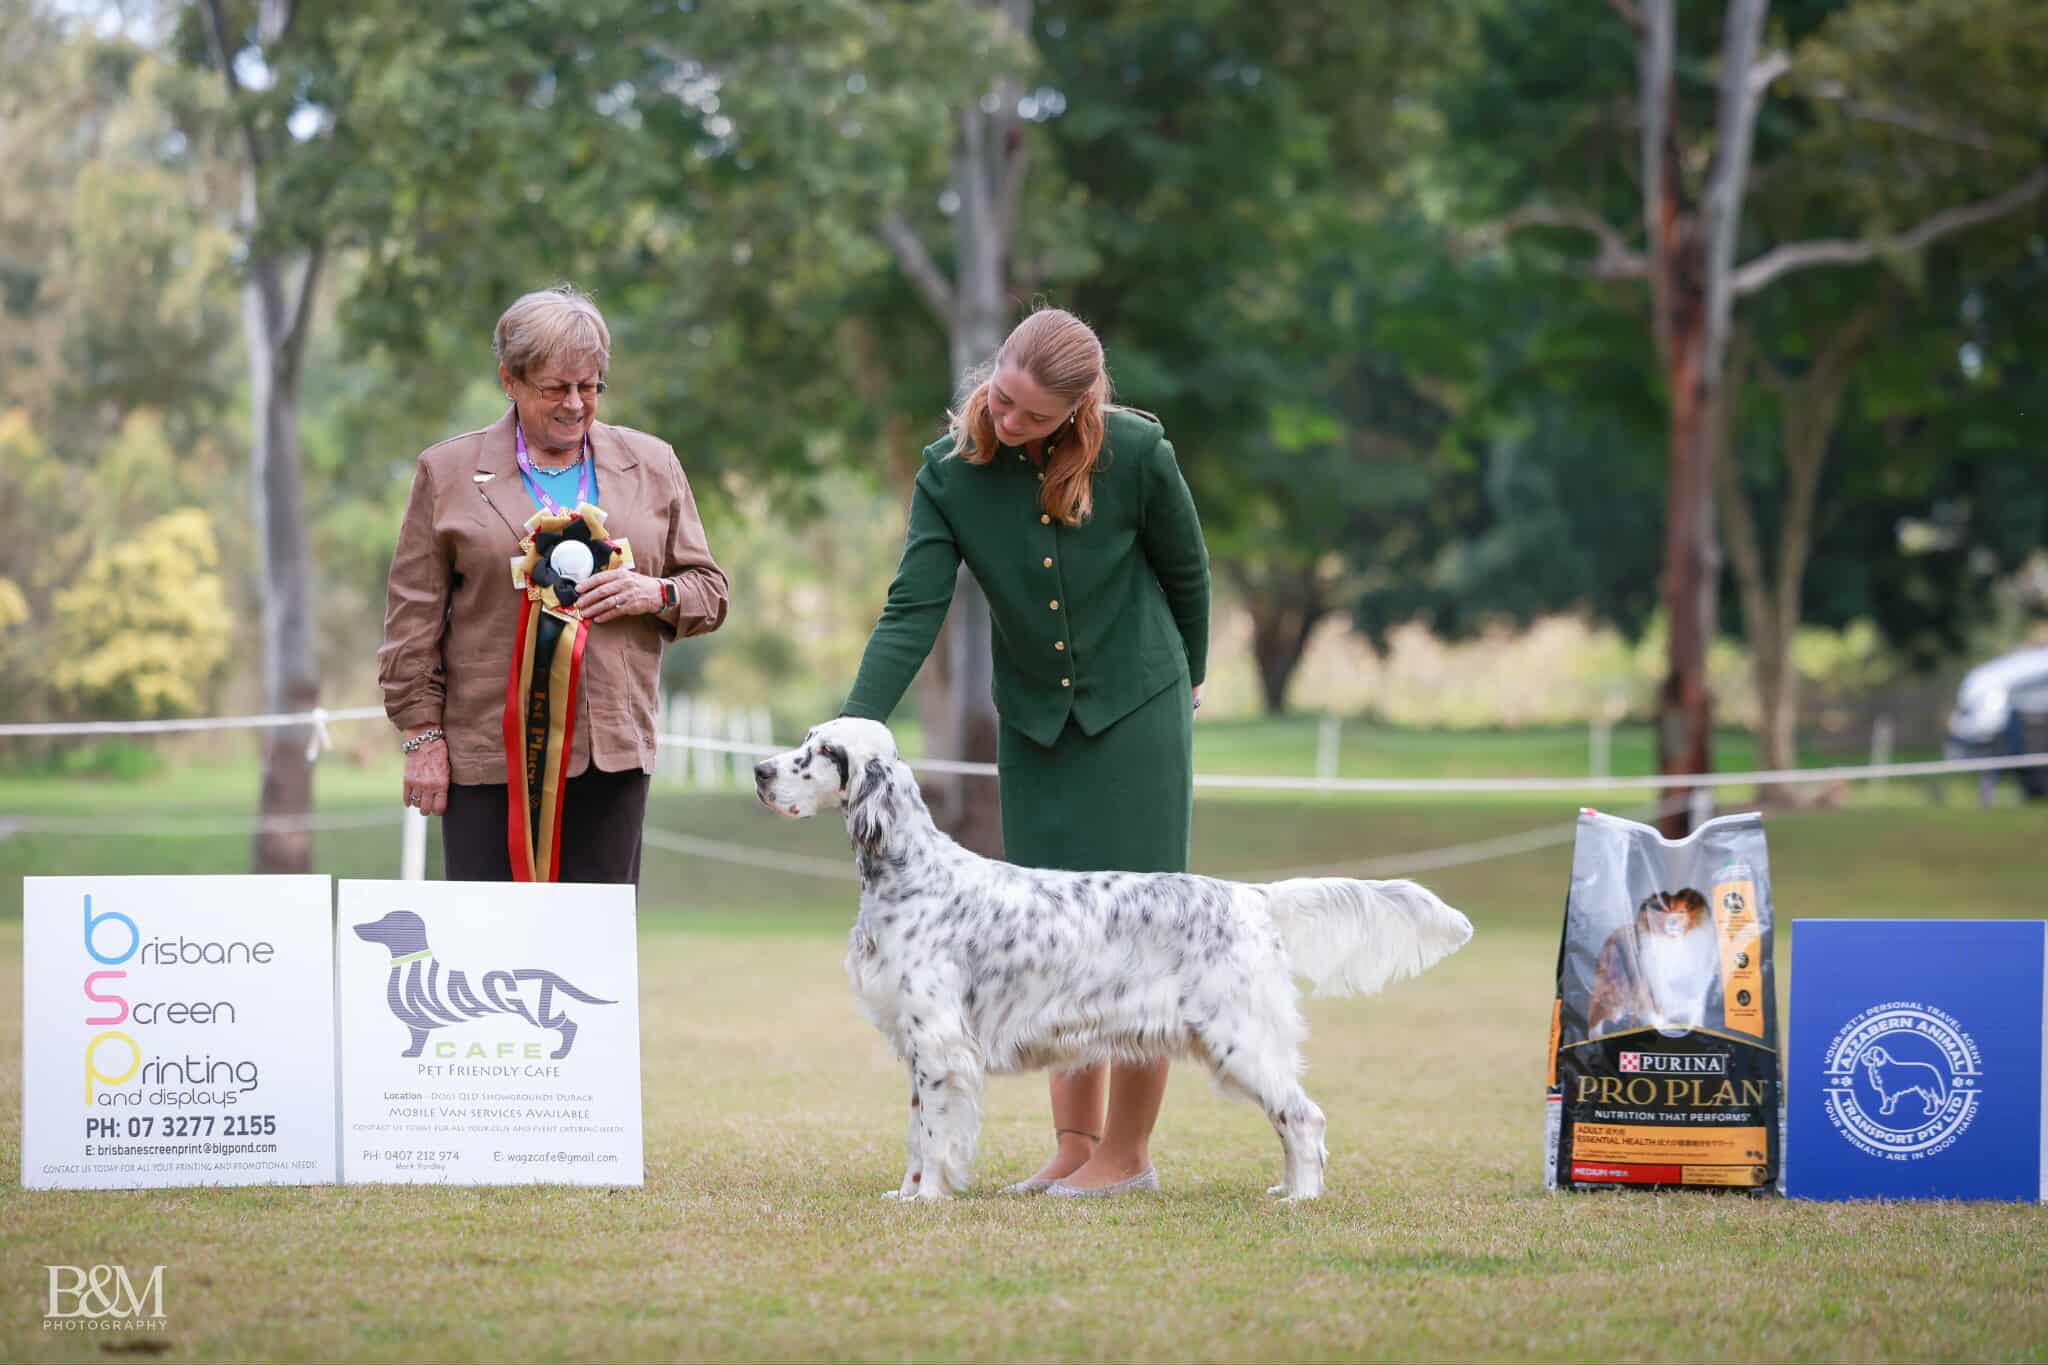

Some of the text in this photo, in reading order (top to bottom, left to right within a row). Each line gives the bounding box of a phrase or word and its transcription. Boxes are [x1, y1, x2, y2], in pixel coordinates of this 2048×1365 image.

[1823, 1036, 1842, 1064] YOUR
[1865, 1001, 1923, 1017] PERSONAL
[1927, 1005, 1961, 1032] TRAVEL
[1960, 1033, 1982, 1065] AGENT
[434, 1042, 544, 1060] CAFE
[1840, 1017, 1965, 1071] AZZABERN ANIMAL
[417, 1063, 561, 1078] PET FRIENDLY CAFE
[1642, 1055, 1721, 1072] PURINA
[97, 1087, 238, 1109] and displays
[384, 1091, 423, 1101] Location
[1576, 1075, 1766, 1107] PRO PLAN
[388, 1107, 436, 1119] MOBILE
[439, 1107, 467, 1118] VAN
[525, 1108, 591, 1120] AVAILABLE
[1594, 1109, 1656, 1121] NUTRITION
[1658, 1112, 1686, 1122] THAT
[1842, 1097, 1963, 1144] TRANSPORT PTY LTD
[86, 1114, 277, 1139] PH: 07 3277 2155
[1823, 1099, 1979, 1161] YOUR ANIMALS ARE IN GOOD HANDS
[1576, 1135, 1620, 1145] ESSENTIAL
[1622, 1137, 1657, 1146] HEALTH
[85, 1142, 278, 1157] E: brisbanescreenprint@bigpond.com
[384, 1150, 413, 1161] 0407
[416, 1150, 436, 1161] 212
[438, 1150, 460, 1161] 974
[507, 1151, 618, 1165] wagzcafe@gmail.com
